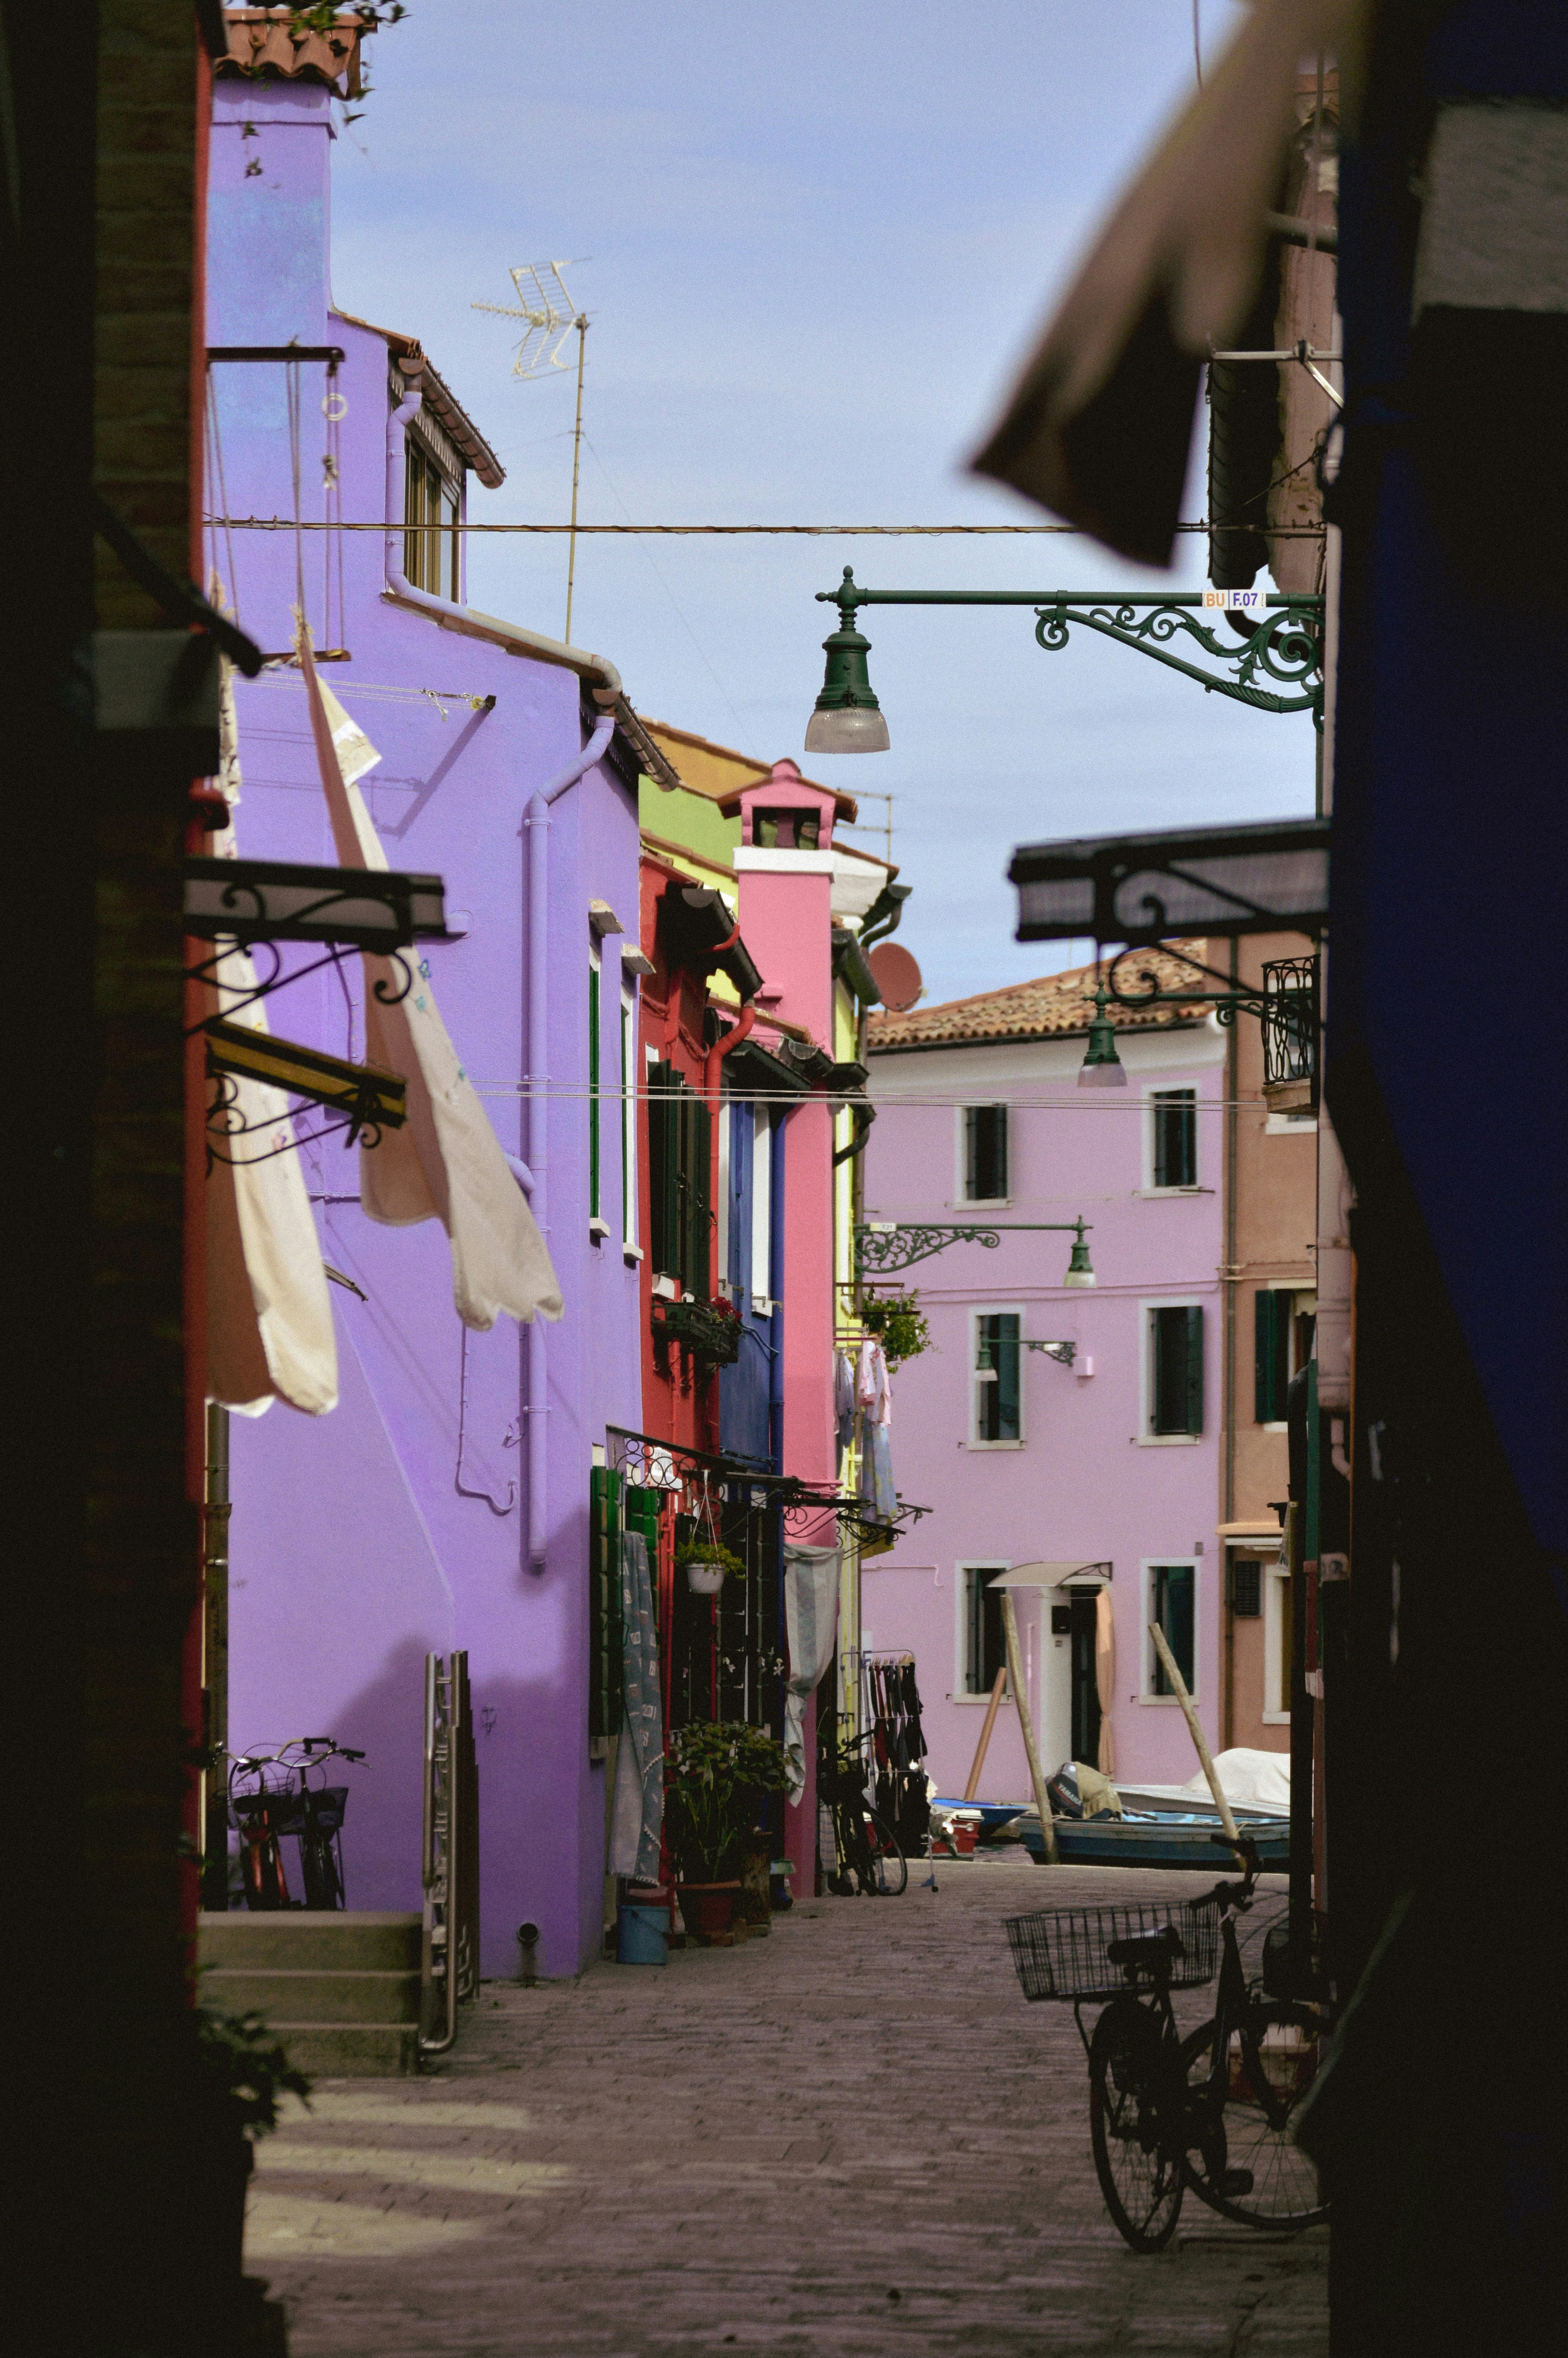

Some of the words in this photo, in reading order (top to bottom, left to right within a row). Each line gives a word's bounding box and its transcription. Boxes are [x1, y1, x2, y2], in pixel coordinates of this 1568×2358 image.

[1206, 593, 1225, 607] BU
[1233, 592, 1258, 606] F.07
[1059, 1783, 1082, 1806] YAMAHA
